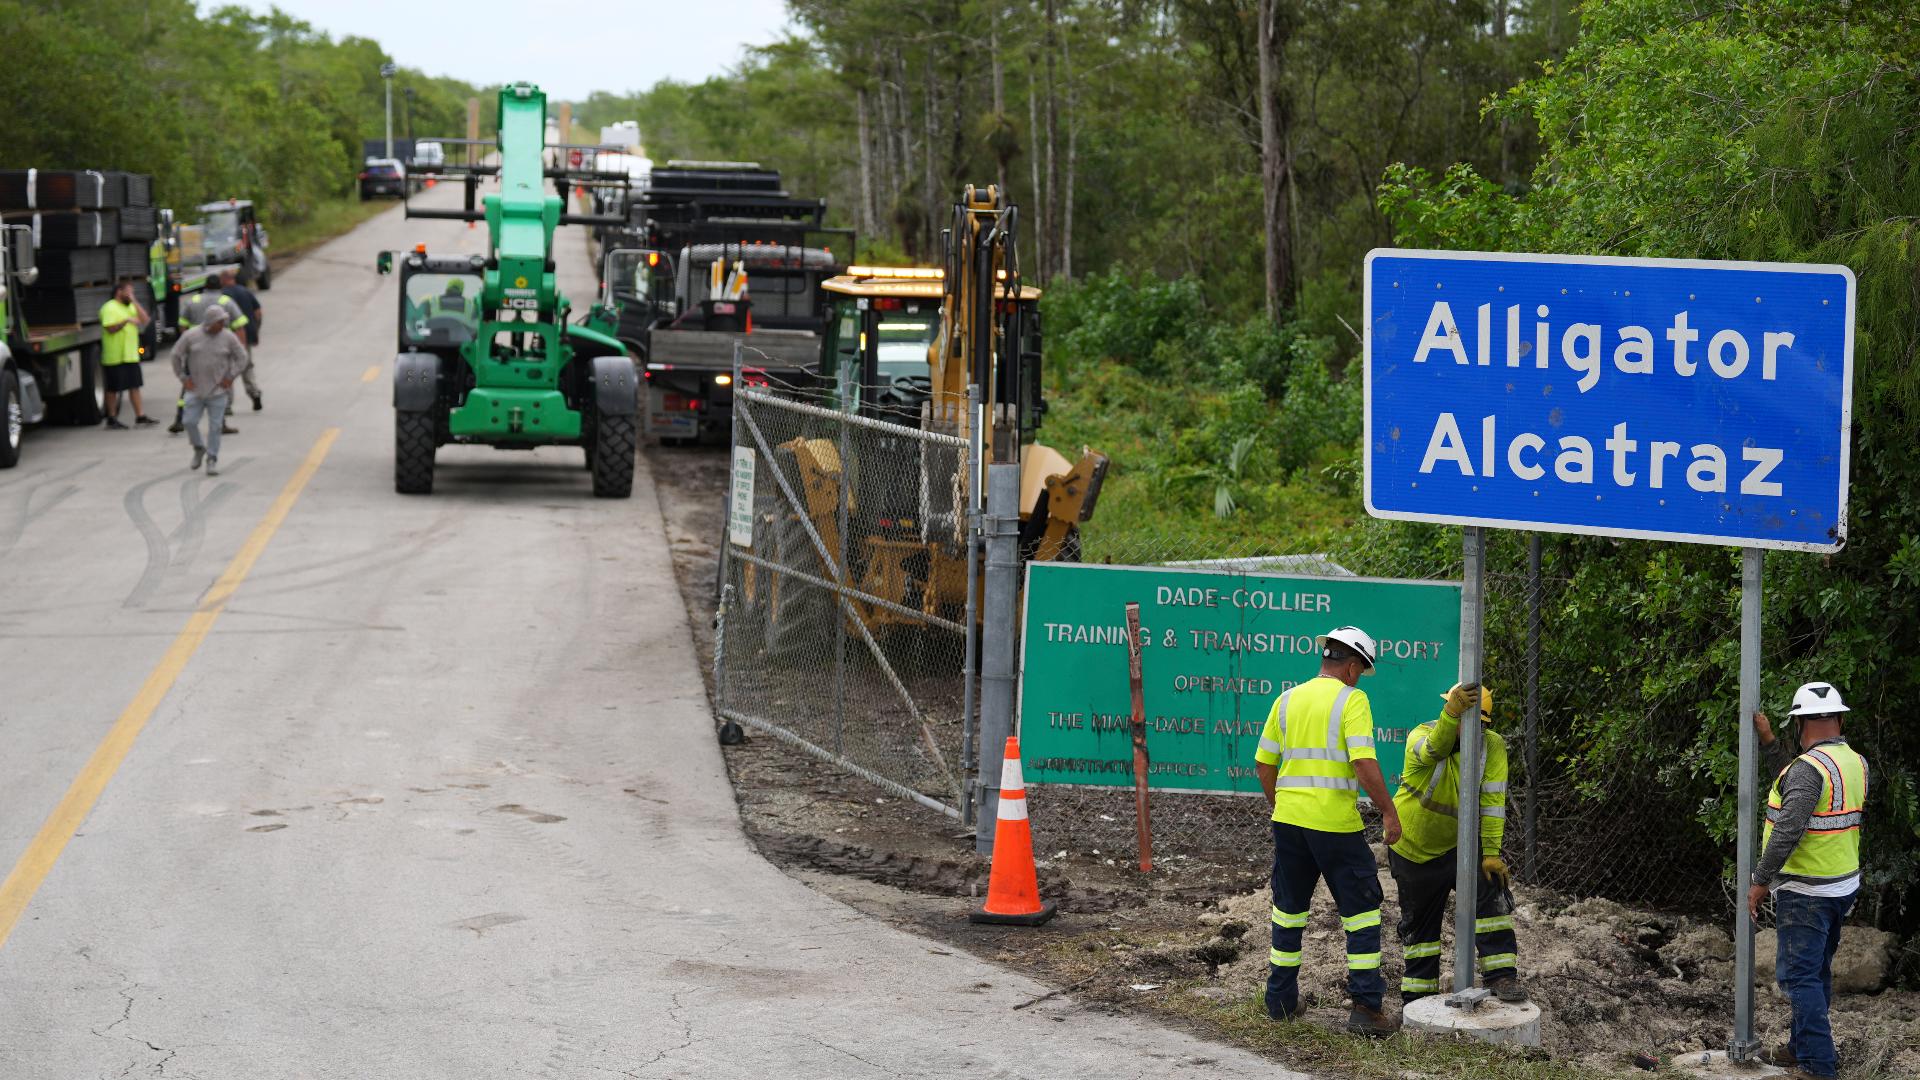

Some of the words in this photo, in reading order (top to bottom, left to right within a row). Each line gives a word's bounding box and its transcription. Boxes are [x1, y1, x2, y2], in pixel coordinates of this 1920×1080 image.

[1412, 300, 1796, 393] Alligator
[1418, 411, 1785, 497] Alcatraz
[1156, 585, 1332, 613] DADE-COLLIER
[1043, 622, 1151, 647] TRAINING
[1162, 628, 1177, 648] &
[1174, 674, 1273, 696] OPERATED
[1047, 711, 1084, 730] THE
